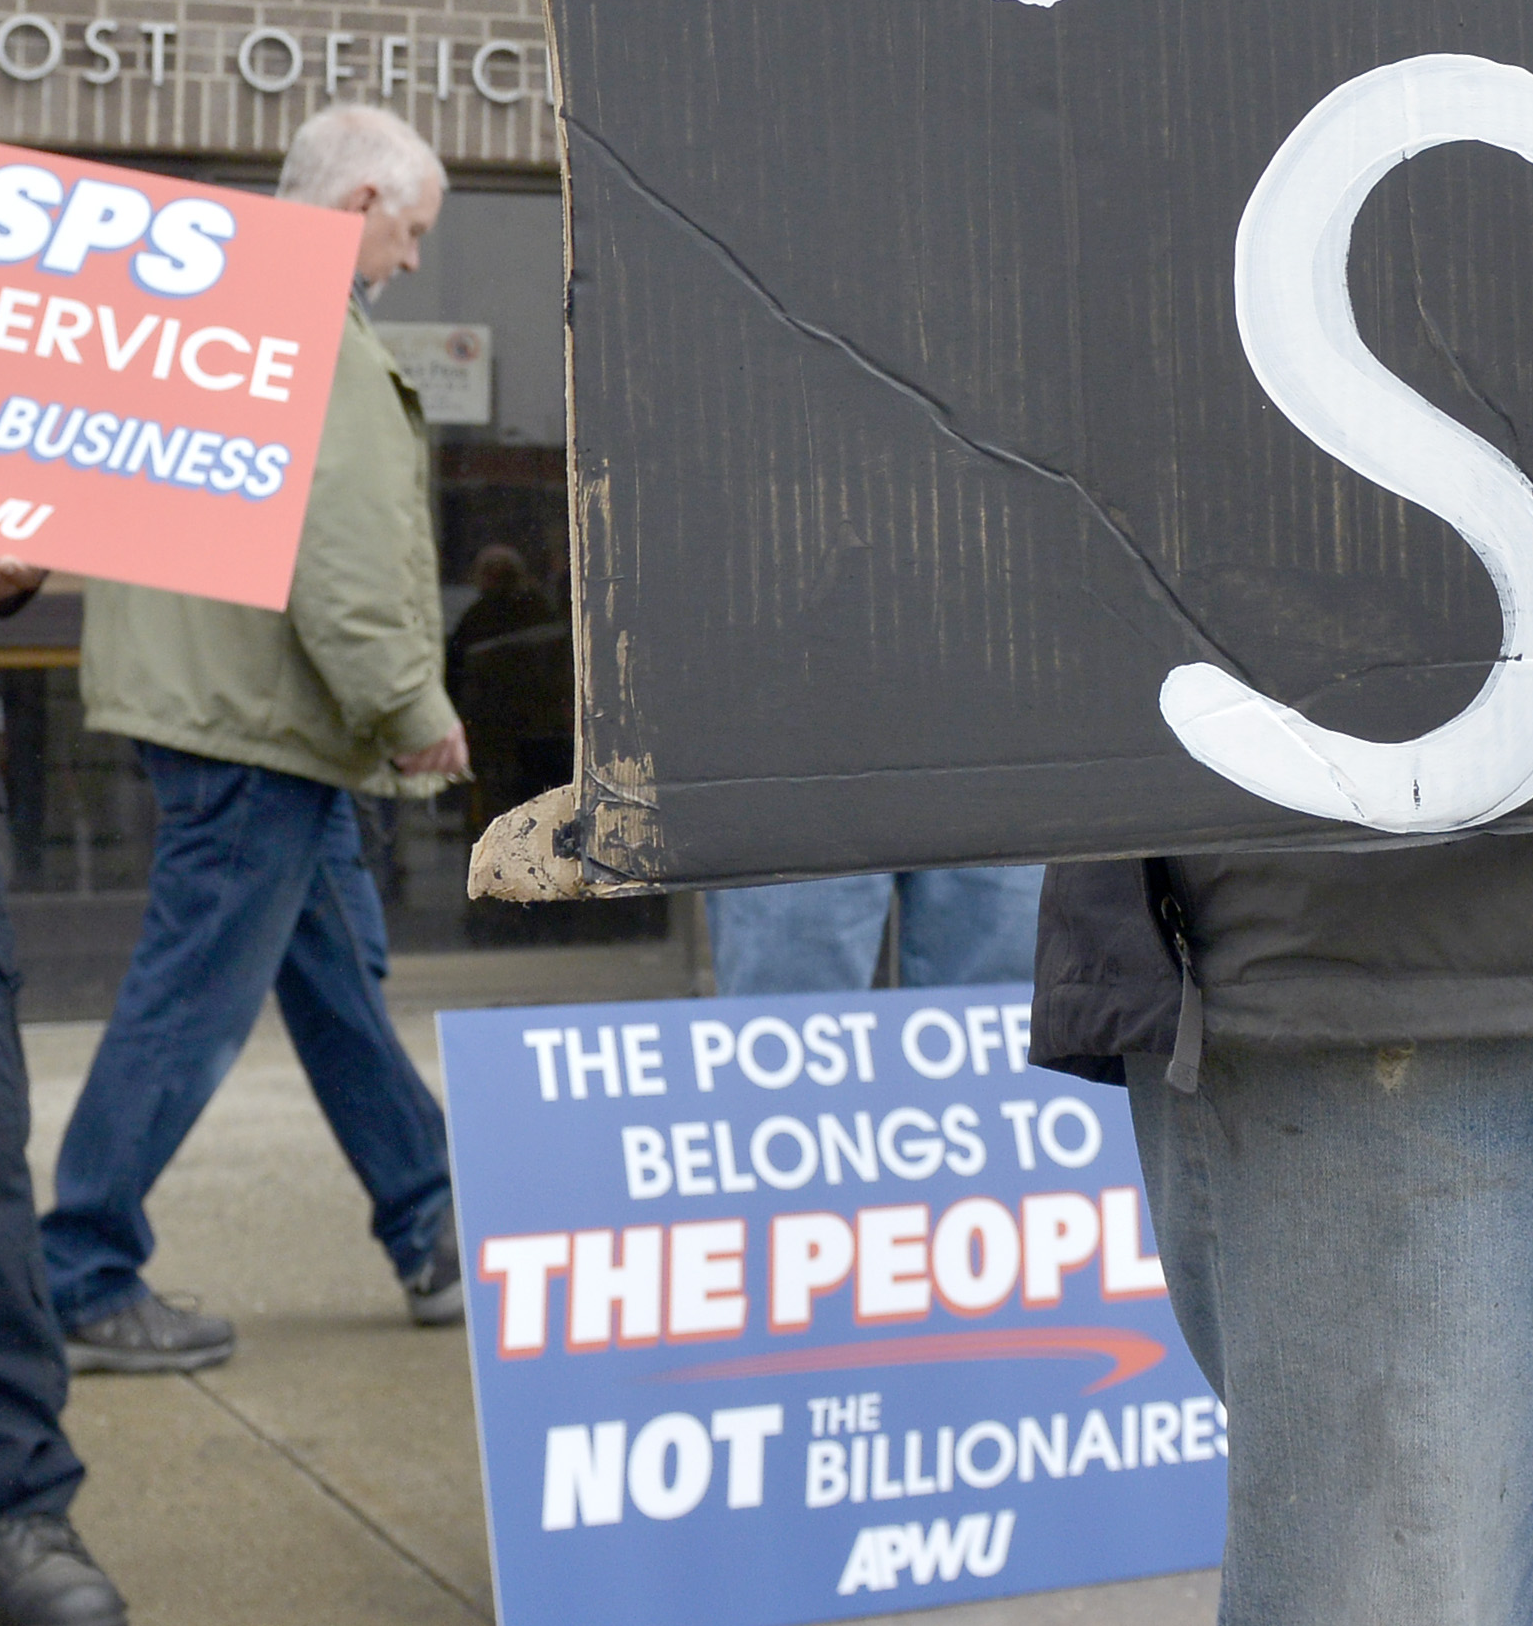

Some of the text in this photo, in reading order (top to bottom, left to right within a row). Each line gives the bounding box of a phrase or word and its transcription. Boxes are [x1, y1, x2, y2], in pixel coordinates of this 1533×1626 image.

[237, 26, 558, 106] OFFIC
[522, 1006, 1031, 1102] THE POST OFF
[621, 1096, 1104, 1200] BELONGS TO
[479, 1185, 1168, 1360] THE PEOPL
[541, 1392, 882, 1532] NOT THE
[834, 1508, 1018, 1597] APWU
